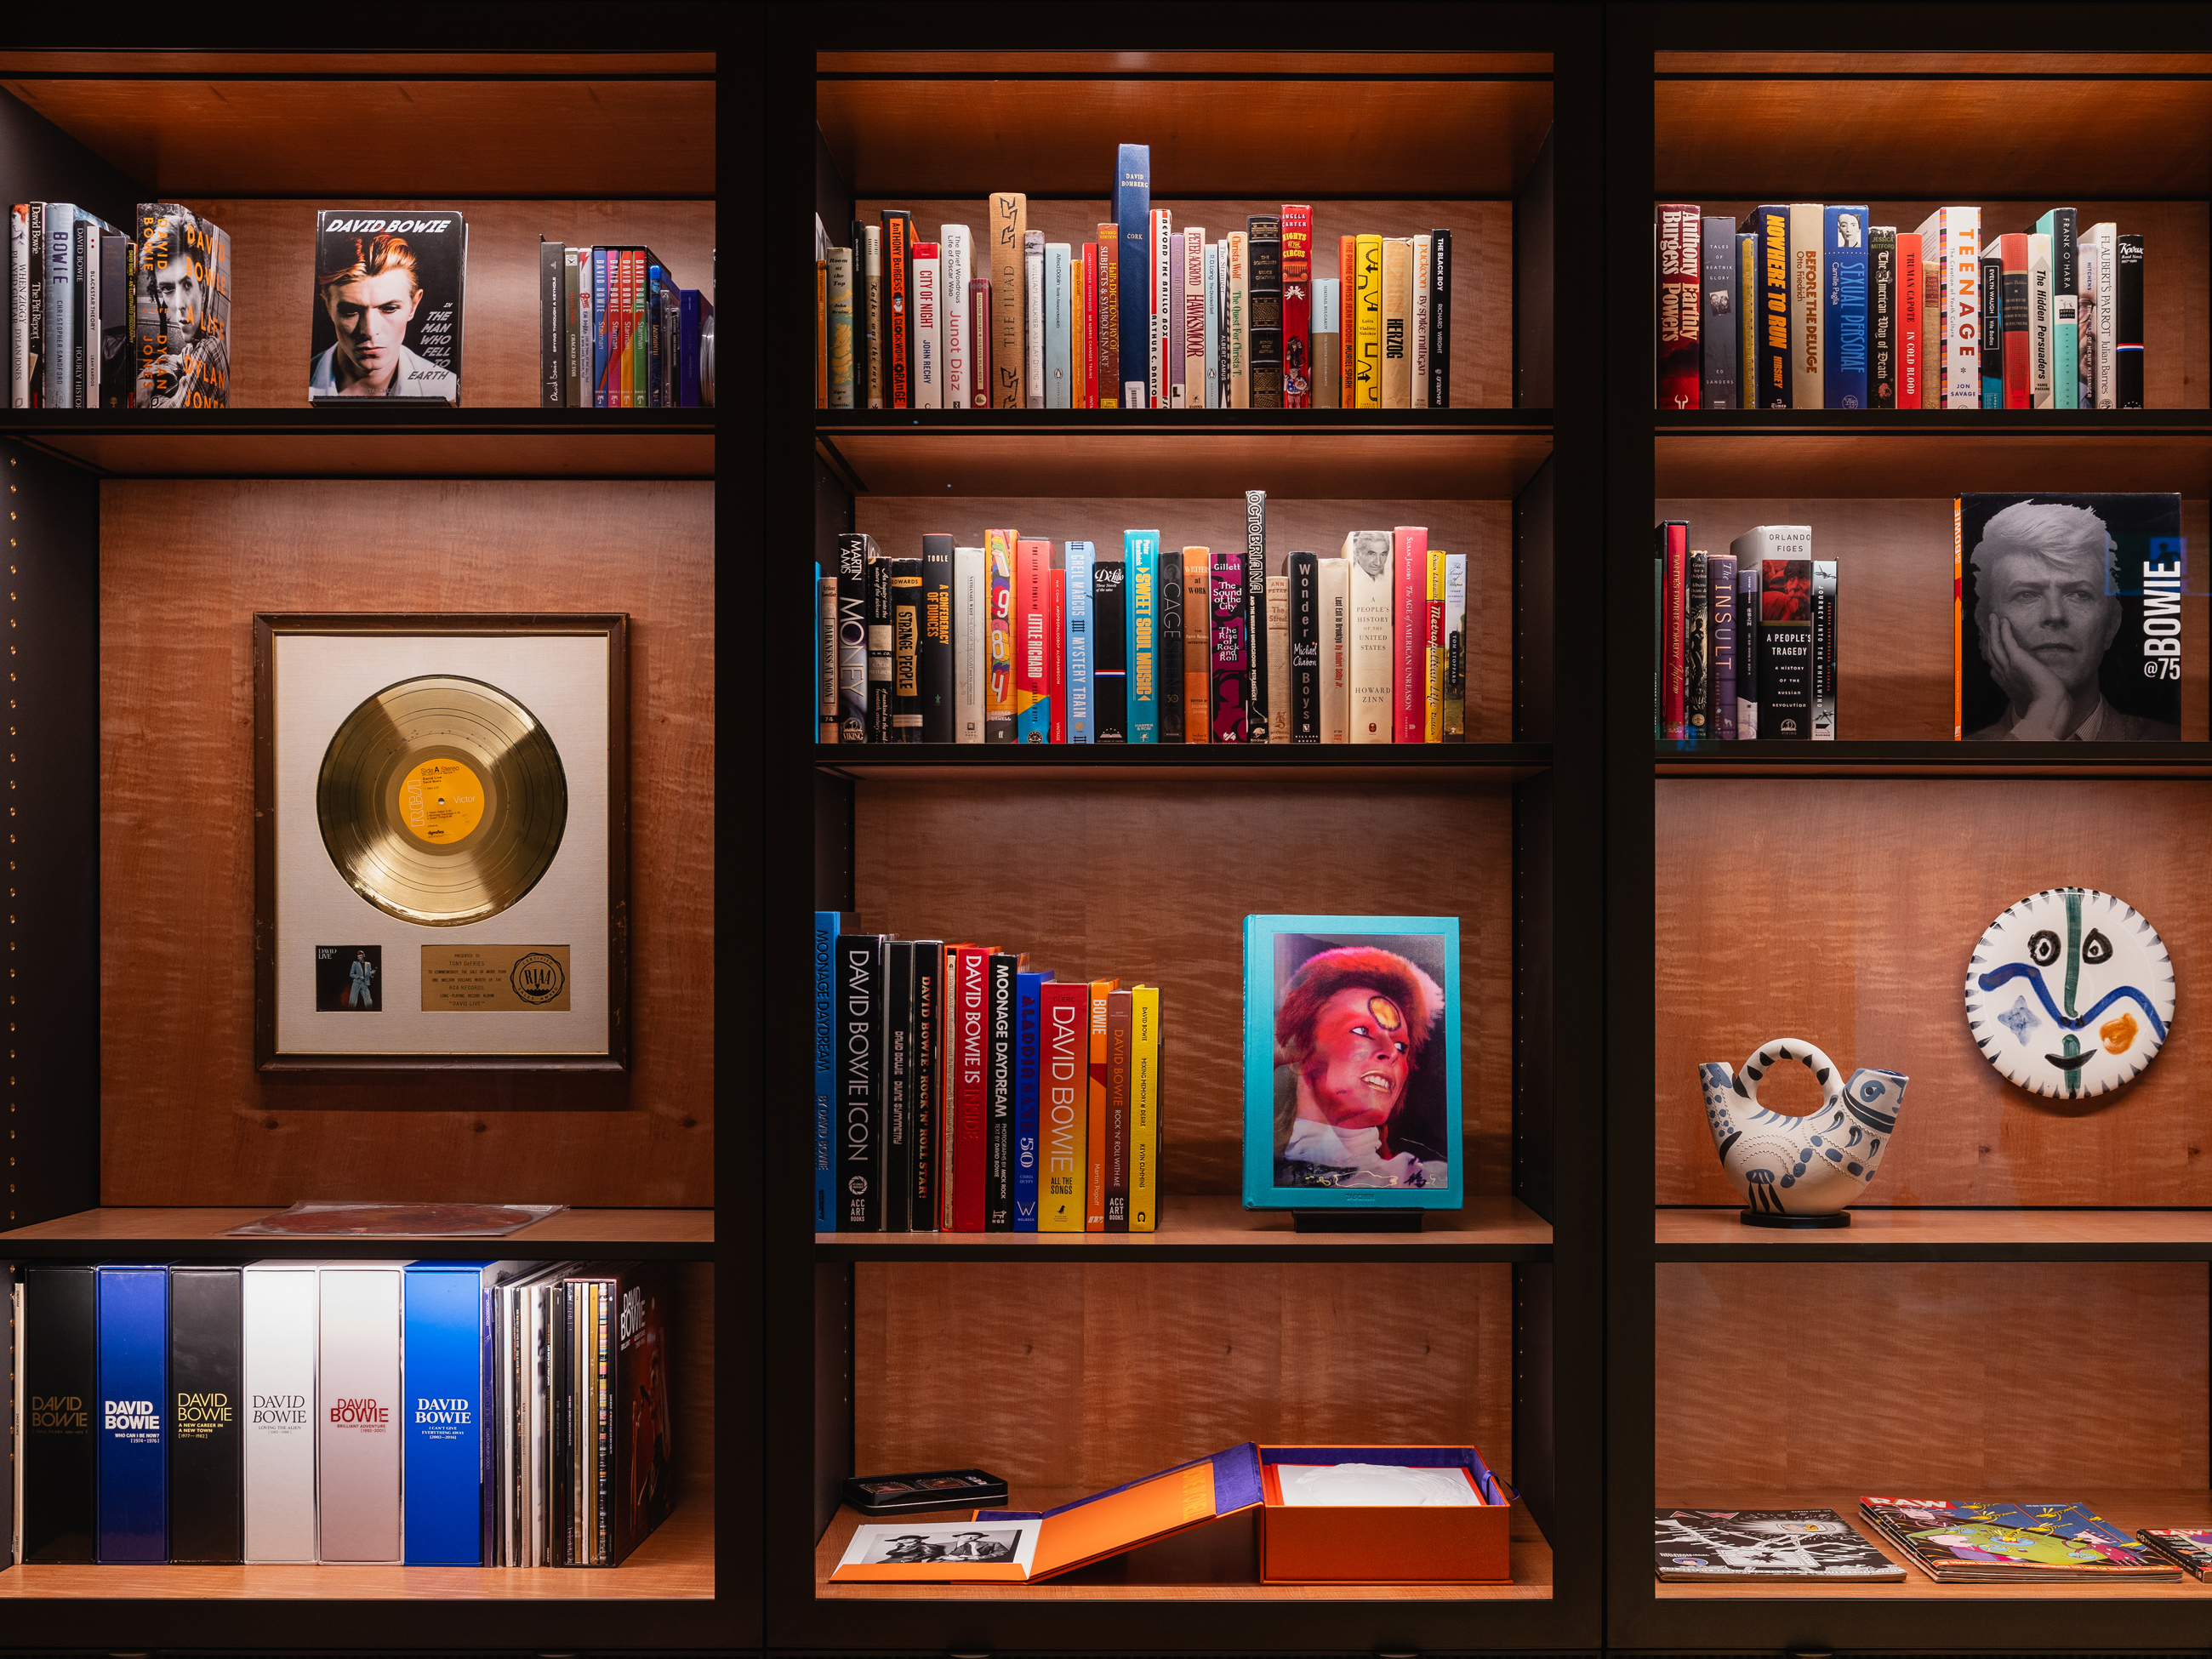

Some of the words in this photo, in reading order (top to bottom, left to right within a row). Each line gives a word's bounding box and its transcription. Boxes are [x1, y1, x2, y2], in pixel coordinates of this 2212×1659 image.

[31, 206, 42, 229] David
[326, 219, 385, 232] DAVID
[385, 219, 452, 233] BOWIE
[31, 230, 42, 254] Bowie
[53, 231, 69, 285] BOWIE
[143, 217, 153, 271] BOWIE
[157, 219, 168, 271] DAVID
[1231, 236, 1241, 262] Christa
[1660, 211, 1681, 275] Burgess
[1679, 211, 1700, 277] Anthony
[1766, 214, 1786, 289] NOWHERE
[596, 259, 605, 284] DAVID
[920, 271, 932, 288] CITY
[1004, 265, 1015, 307] ILIAD
[1231, 264, 1241, 280] Wolf
[1805, 251, 1817, 298] BEFORE
[1840, 263, 1864, 309] SEXUAL
[2037, 270, 2046, 287] The
[31, 282, 42, 297] The
[596, 288, 605, 313] BOWIE
[920, 291, 932, 303] OF
[1768, 292, 1786, 311] TO
[1959, 229, 1975, 356] TEENAGE
[31, 299, 42, 313] Pitt
[426, 311, 453, 322] THE
[920, 305, 932, 329] NIGHT
[1662, 282, 1681, 342] Powers
[1679, 282, 1700, 341] Earthly
[1805, 299, 1817, 324] THE
[2037, 290, 2046, 322] Hidden
[31, 314, 42, 339] Report
[420, 323, 452, 333] MAN
[420, 335, 452, 345] WHO
[949, 311, 962, 353] Junot
[1005, 316, 1015, 348] THE
[1187, 294, 1205, 357] HAWKSMOOR
[1387, 318, 1404, 359] HERZOG
[1769, 315, 1787, 349] RUN
[422, 347, 450, 356] FELL
[923, 339, 932, 360] JOHN
[1805, 327, 1817, 373] DELUGE
[1840, 315, 1864, 373] PERSONAE
[2037, 325, 2046, 379] Persuaders
[143, 335, 153, 389] JONES
[157, 335, 168, 390] DYLAN
[407, 371, 449, 380] EARTH
[433, 359, 450, 368] TO
[923, 362, 932, 385] RECHY
[949, 356, 962, 391] Díaz
[1774, 356, 1782, 389] HIRSHEY
[841, 548, 851, 574] AMIS
[852, 540, 862, 581] MARTIN
[1070, 555, 1086, 582] GREIL
[927, 592, 938, 602] OF
[1070, 584, 1086, 616] MARCUS
[1136, 573, 1151, 616] SWEET
[1163, 583, 1181, 638] CAGE
[2143, 561, 2181, 656] BOWIE
[898, 612, 913, 652] STRANGE
[927, 604, 938, 637] DUNCES
[939, 591, 949, 645] CONFEDERACY
[1136, 618, 1151, 650] SOUL
[1715, 584, 1732, 670] INSULT
[840, 596, 864, 698] MONEY
[1072, 637, 1086, 683] MYSTERY
[1771, 647, 1807, 656] TRAGEDY
[898, 655, 913, 690] PEOPLE
[1137, 653, 1151, 696] MUSIC
[2144, 658, 2181, 680] @75
[1072, 687, 1086, 718] TRAIN
[524, 968, 550, 985] RIAA
[817, 930, 830, 998] MOONAGE
[848, 950, 869, 1017] DAVID
[964, 955, 983, 1008] DAVID
[996, 965, 1009, 1039] MOONAGE
[1092, 999, 1106, 1035] BOWIE
[817, 1001, 830, 1072] DAYDREAM
[964, 1011, 983, 1067] BOWIE
[1052, 1006, 1075, 1080] DAVID
[848, 1021, 869, 1096] BOWIE
[964, 1070, 983, 1084] IS
[995, 1042, 1008, 1119] DAYDREAM
[848, 1102, 869, 1160] ICON
[1051, 1087, 1075, 1172] BOWIE
[1019, 1137, 1034, 1168] 50
[1051, 1177, 1061, 1186] ALL
[1063, 1177, 1073, 1186] THE
[1051, 1186, 1073, 1195] SONGS
[851, 1199, 865, 1207] ACC
[851, 1207, 865, 1216] ART
[32, 1396, 82, 1411] DAVID
[105, 1401, 153, 1415] DAVID
[178, 1393, 227, 1407] DAVID
[178, 1407, 232, 1422] BOWIE
[253, 1395, 305, 1408] DAVID
[330, 1408, 389, 1422] BOWIE
[337, 1399, 377, 1409] DAVID
[417, 1399, 469, 1411] DAVID
[32, 1412, 88, 1427] BOWIE
[105, 1416, 160, 1429] BOWIE
[253, 1411, 307, 1423] BOWIE
[415, 1412, 471, 1424] BOWIE
[1867, 1497, 1947, 1508] RAW
